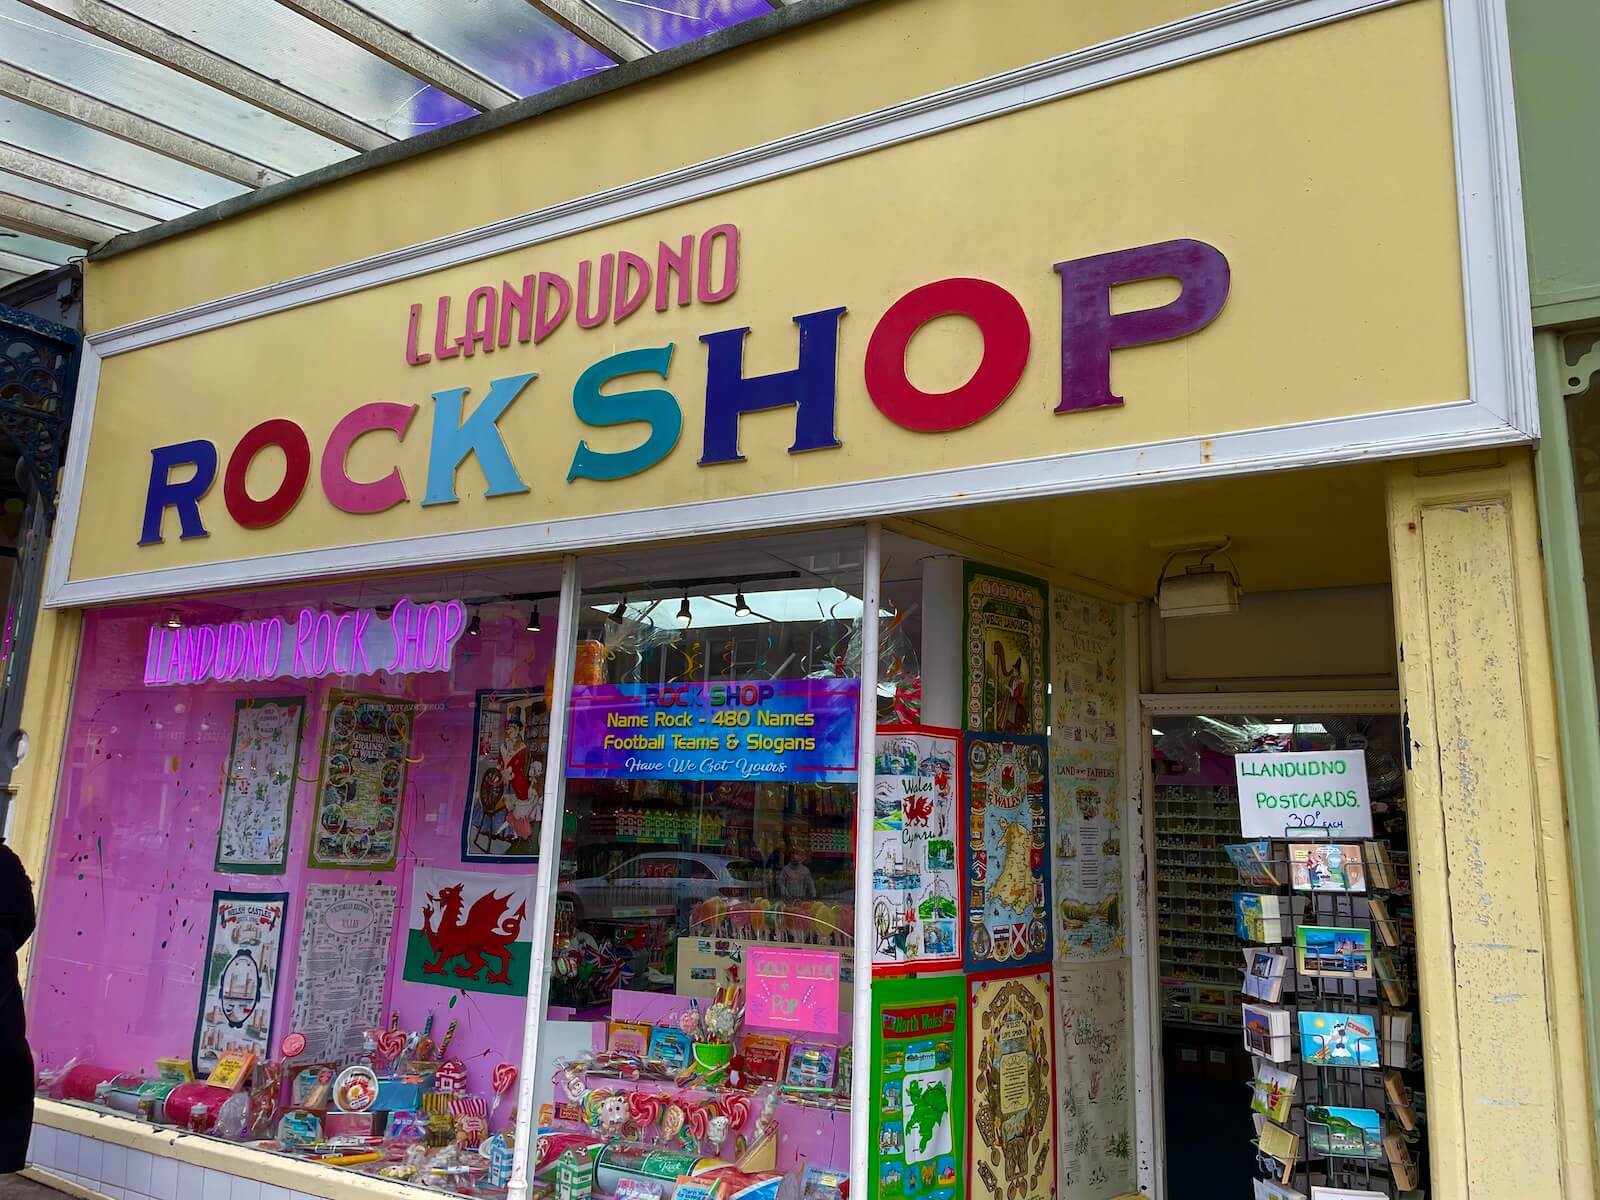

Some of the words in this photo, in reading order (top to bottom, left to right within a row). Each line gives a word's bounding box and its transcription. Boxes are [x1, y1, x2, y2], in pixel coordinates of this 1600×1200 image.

[407, 223, 740, 366] LLANDUDNO
[137, 372, 538, 546] ROCK
[566, 238, 1231, 483] SHOP
[143, 616, 282, 685] LLANDUDNO
[293, 607, 370, 675] ROCK
[388, 596, 463, 674] SHOP
[646, 684, 704, 708] ROCK
[709, 684, 775, 707] SHOP
[606, 712, 649, 728] Name
[654, 711, 693, 727] Rock
[711, 710, 751, 728] 480
[756, 710, 815, 727] Names
[352, 740, 384, 752] TRAINS
[603, 734, 665, 750] Football
[671, 734, 720, 750] Teams
[725, 735, 740, 750] &
[745, 734, 816, 753] Slogans
[624, 757, 664, 773] Have
[667, 757, 697, 773] We
[699, 757, 730, 774] Got
[736, 758, 788, 778] Yours
[1241, 760, 1347, 778] LLANDUDNO
[901, 776, 933, 795] Wales
[1256, 790, 1361, 809] POSTCARDS.
[1323, 820, 1344, 829] EACH
[901, 827, 936, 849] Cymru
[247, 906, 272, 919] CASTLES
[895, 1014, 919, 1034] North
